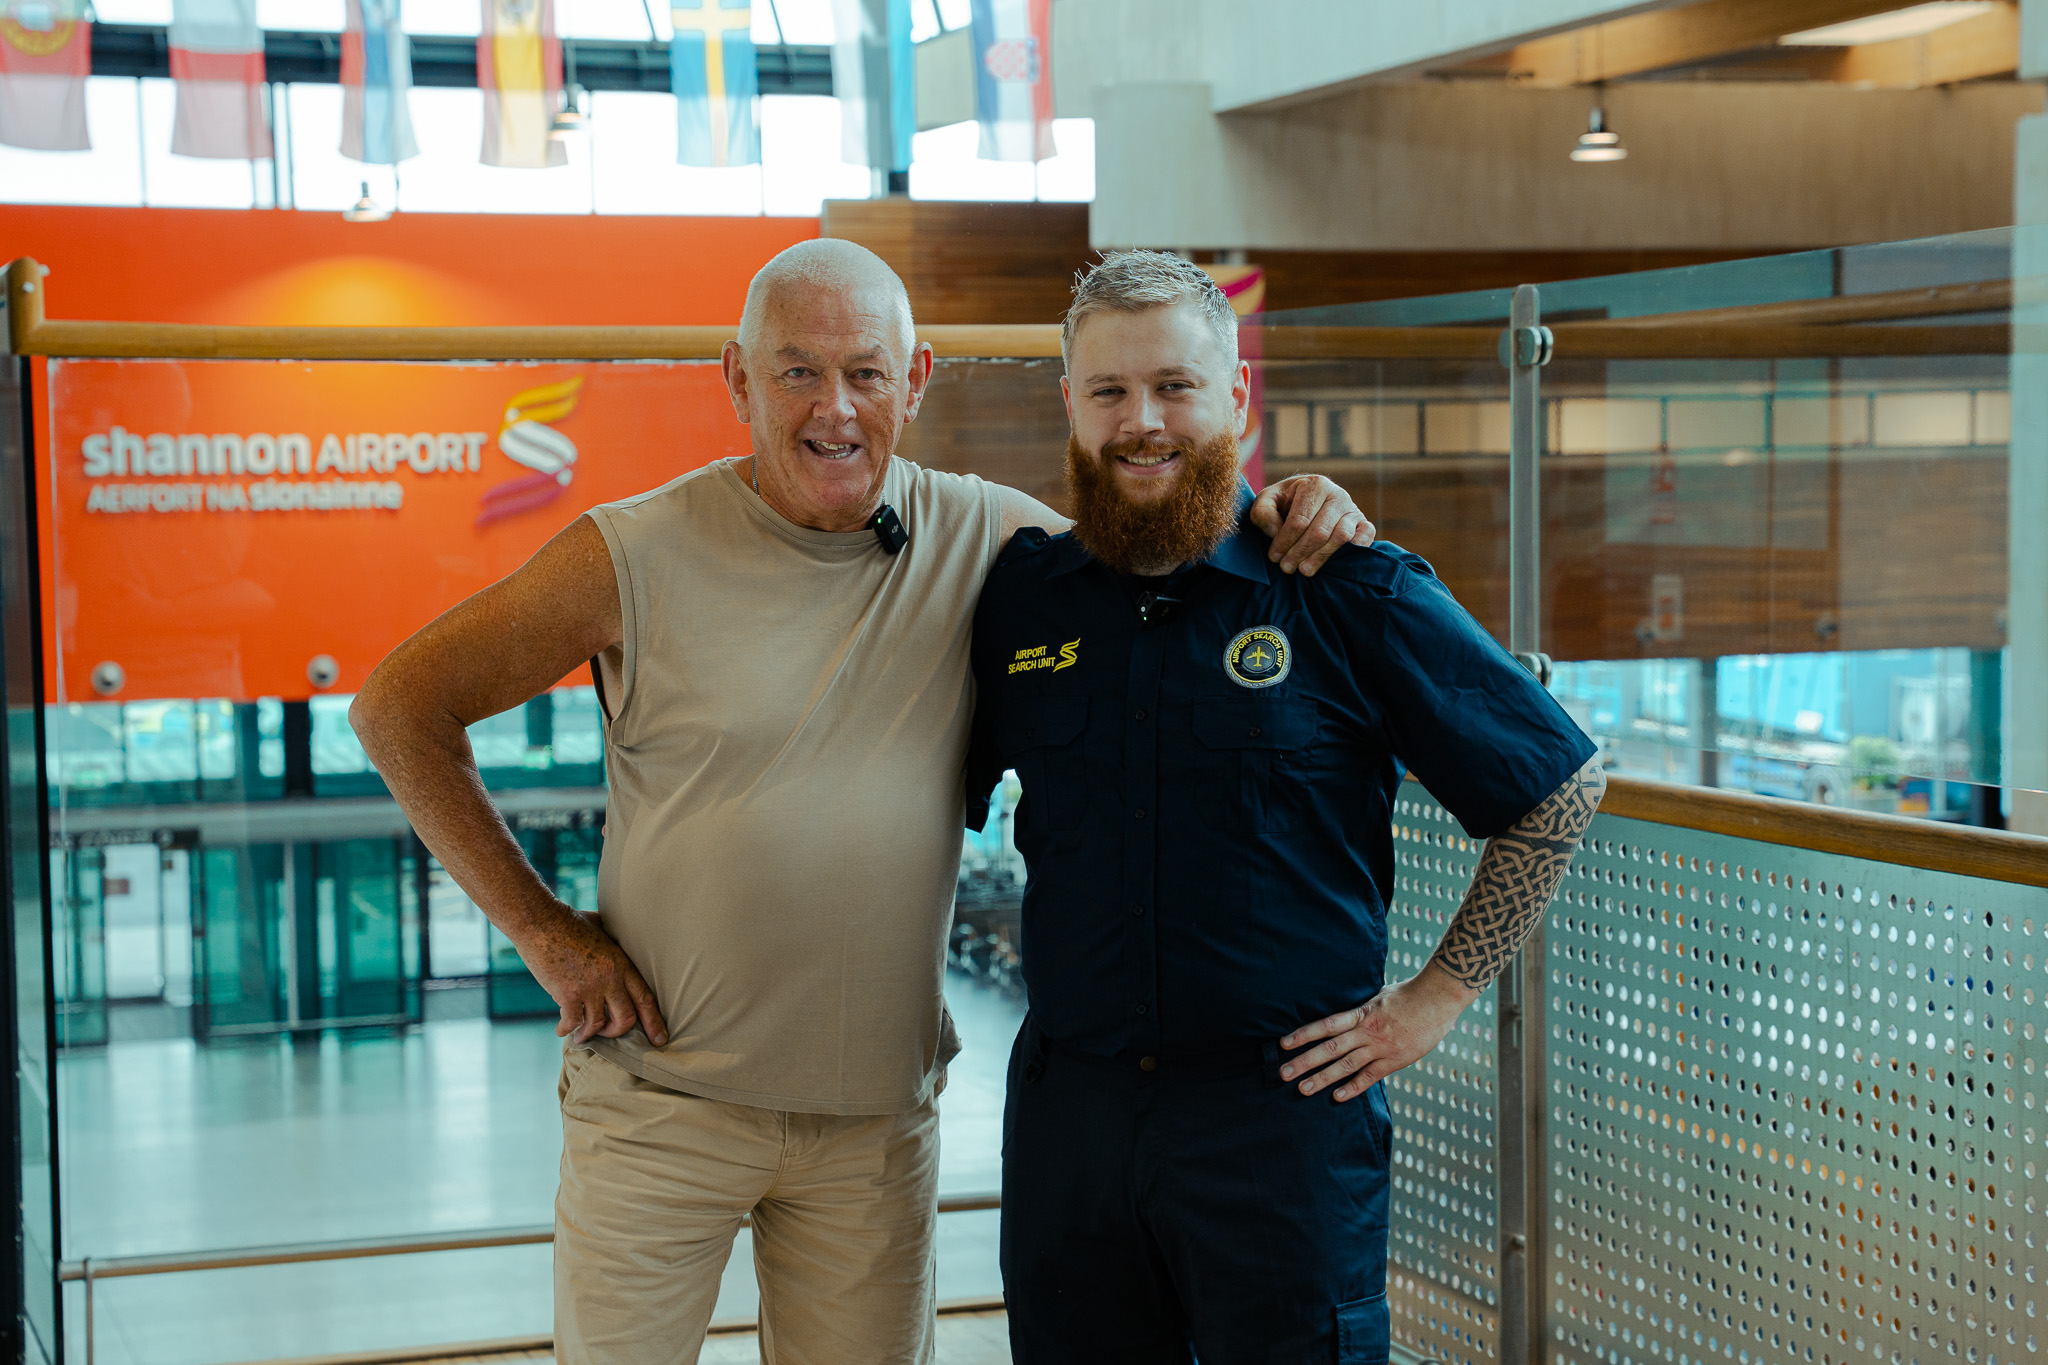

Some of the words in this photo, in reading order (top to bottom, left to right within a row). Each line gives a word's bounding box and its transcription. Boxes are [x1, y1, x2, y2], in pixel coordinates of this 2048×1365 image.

[82, 425, 311, 476] shannon
[316, 431, 487, 474] AIRPORT
[206, 482, 248, 512] NA
[249, 477, 404, 512] sionainne
[1008, 659, 1037, 675] SEARCH
[1037, 656, 1056, 669] UNIT
[1015, 645, 1047, 660] AIRPORT
[1232, 636, 1252, 663] AIRPORT
[1253, 633, 1282, 650] SEARCH
[1276, 650, 1284, 668] UNIT
